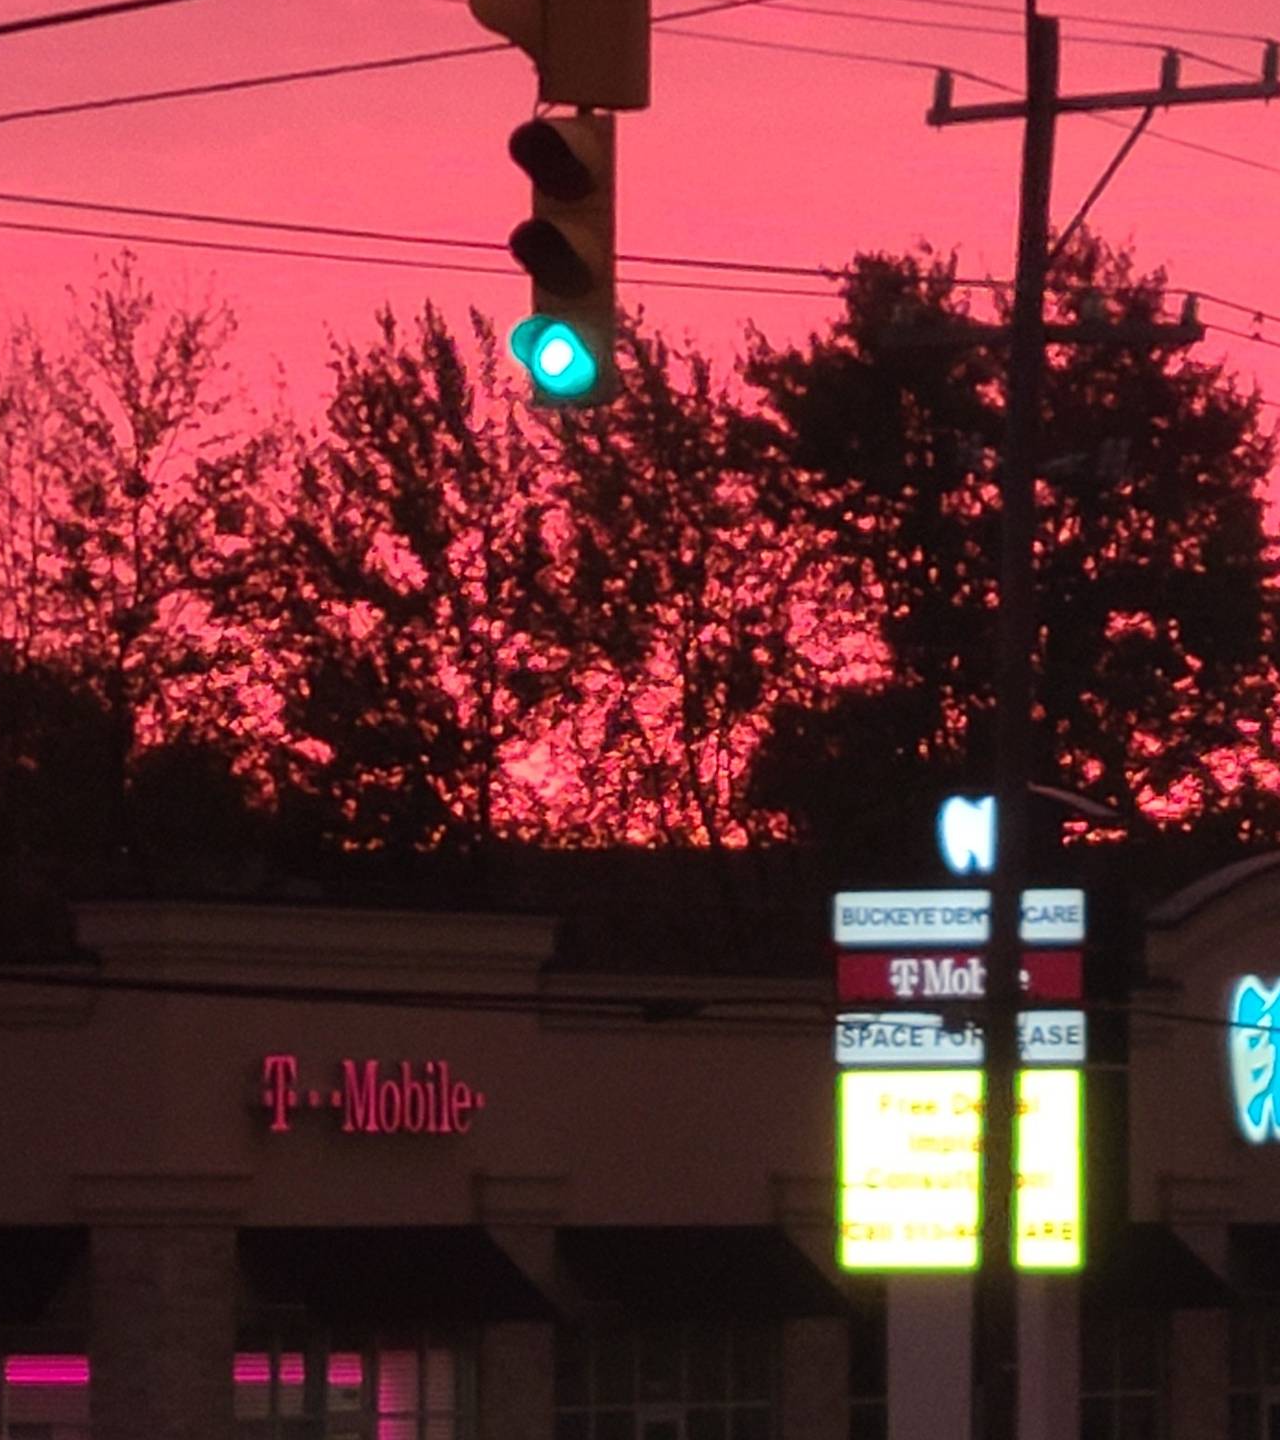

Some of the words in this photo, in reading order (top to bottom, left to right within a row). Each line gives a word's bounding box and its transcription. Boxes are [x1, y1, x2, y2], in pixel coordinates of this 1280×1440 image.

[841, 906, 937, 926] BUCKEYE
[1023, 904, 1080, 924] CARE
[840, 1024, 925, 1048] SPACE
